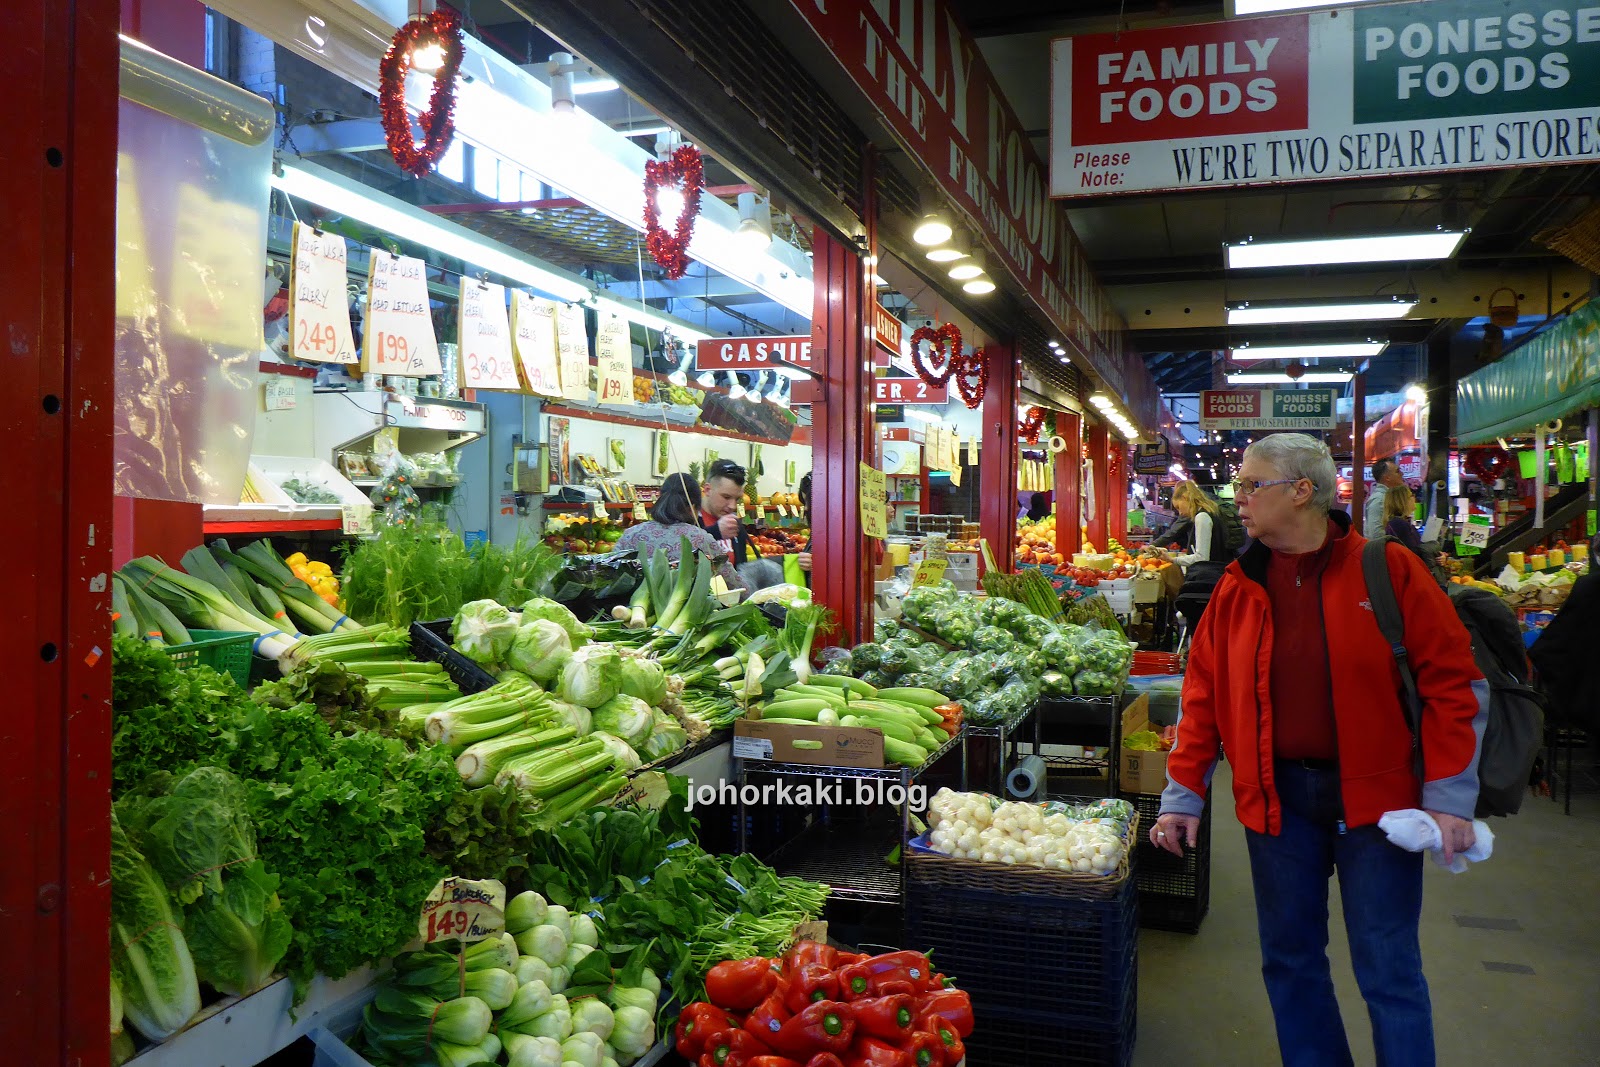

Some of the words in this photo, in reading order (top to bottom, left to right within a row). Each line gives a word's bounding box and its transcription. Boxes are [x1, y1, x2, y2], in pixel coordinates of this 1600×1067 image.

[1365, 7, 1600, 61] PONESSE
[1097, 37, 1280, 86] FAMILY
[1398, 52, 1571, 100] FOODS
[1100, 77, 1278, 124] FOODS
[860, 10, 926, 142] THE
[948, 136, 1035, 283] FRESHEST
[1172, 141, 1258, 184] WE'RE
[1266, 135, 1329, 178] TWO
[1338, 123, 1486, 173] SEPARATE
[1495, 113, 1600, 162] STORE
[1073, 150, 1131, 170] Please
[1080, 170, 1125, 188] Note:
[876, 311, 899, 346] ASHIER
[720, 343, 811, 362] CASHIE
[916, 382, 927, 398] 2
[1210, 394, 1254, 404] FAMILY
[1275, 394, 1329, 403] PONESSE
[1210, 404, 1254, 413] FOODS
[1282, 403, 1322, 413] FOODS
[1252, 418, 1267, 428] TWO
[1268, 418, 1302, 428] SEPARATE
[1303, 418, 1330, 428] STORES
